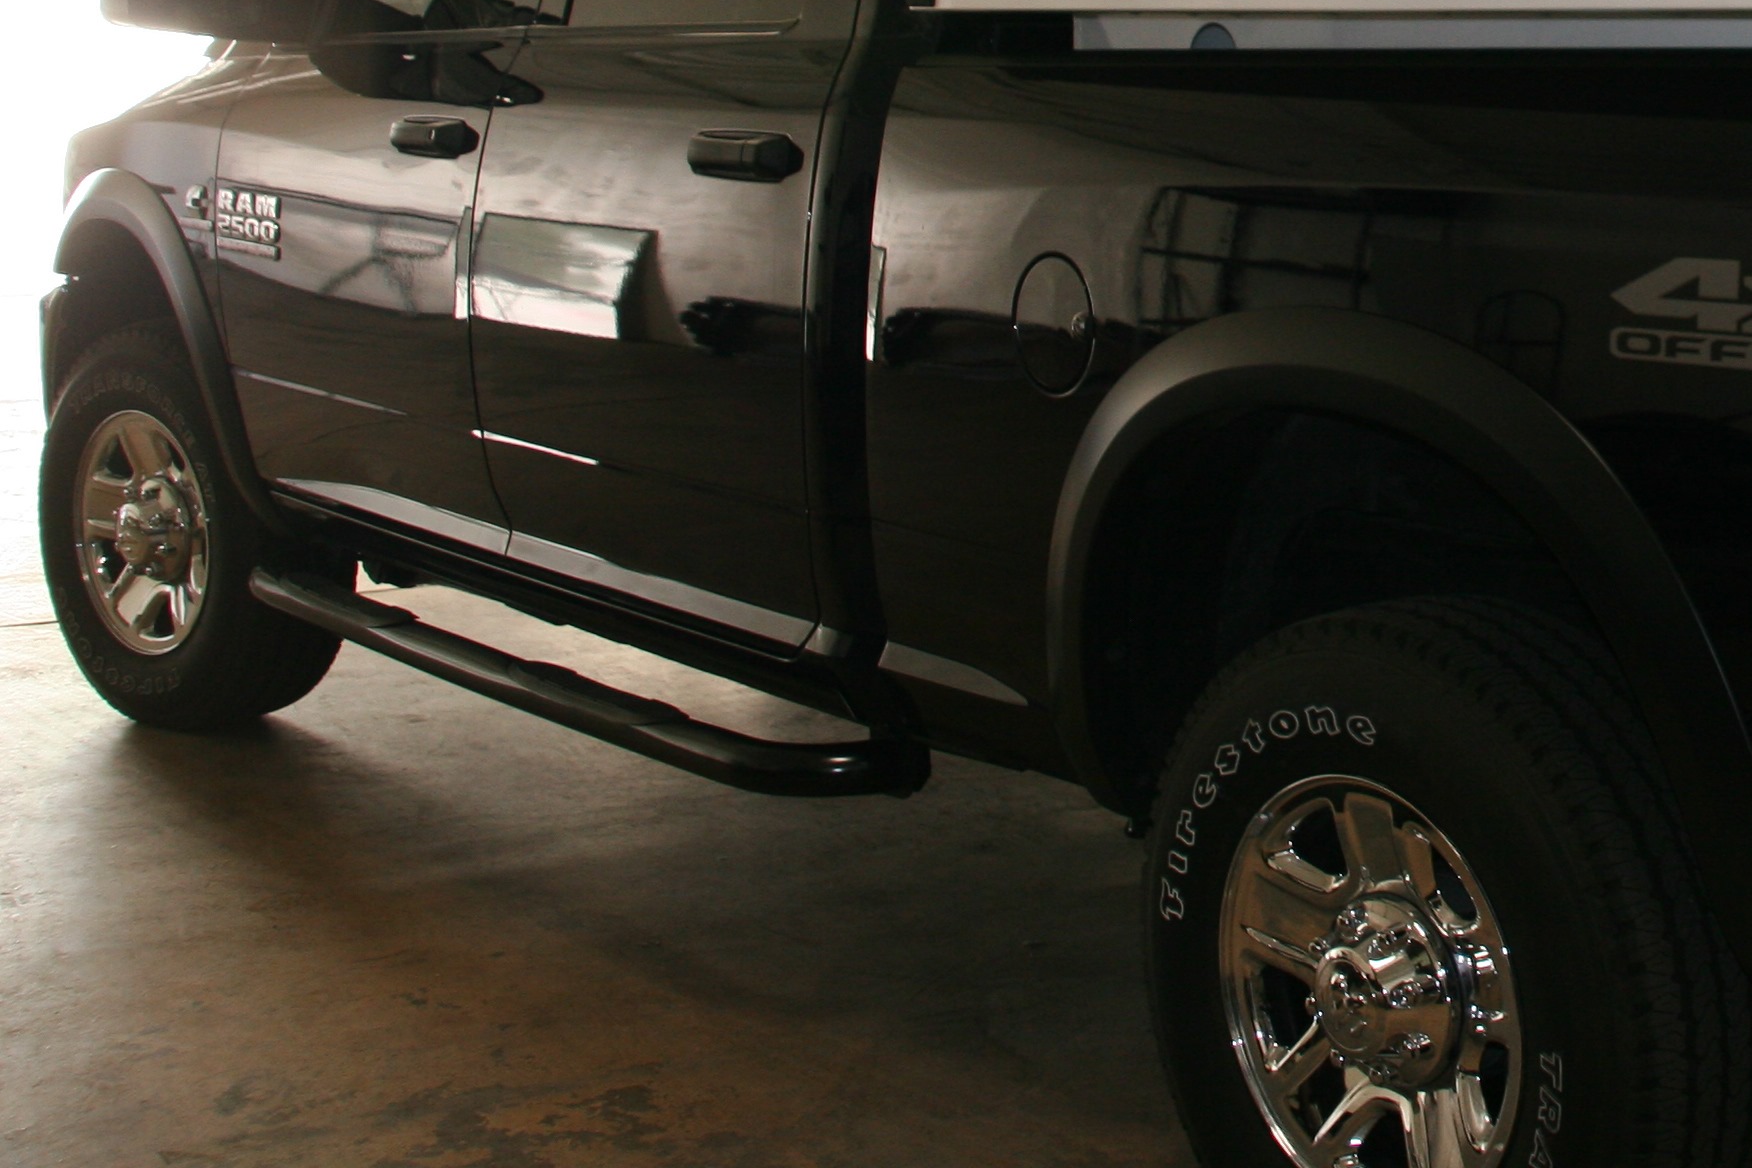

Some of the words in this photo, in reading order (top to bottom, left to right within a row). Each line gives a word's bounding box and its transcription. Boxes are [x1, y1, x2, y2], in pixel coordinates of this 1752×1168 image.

[217, 188, 279, 219] RAM
[217, 212, 280, 242] 2500
[1158, 703, 1379, 923] Firestone
